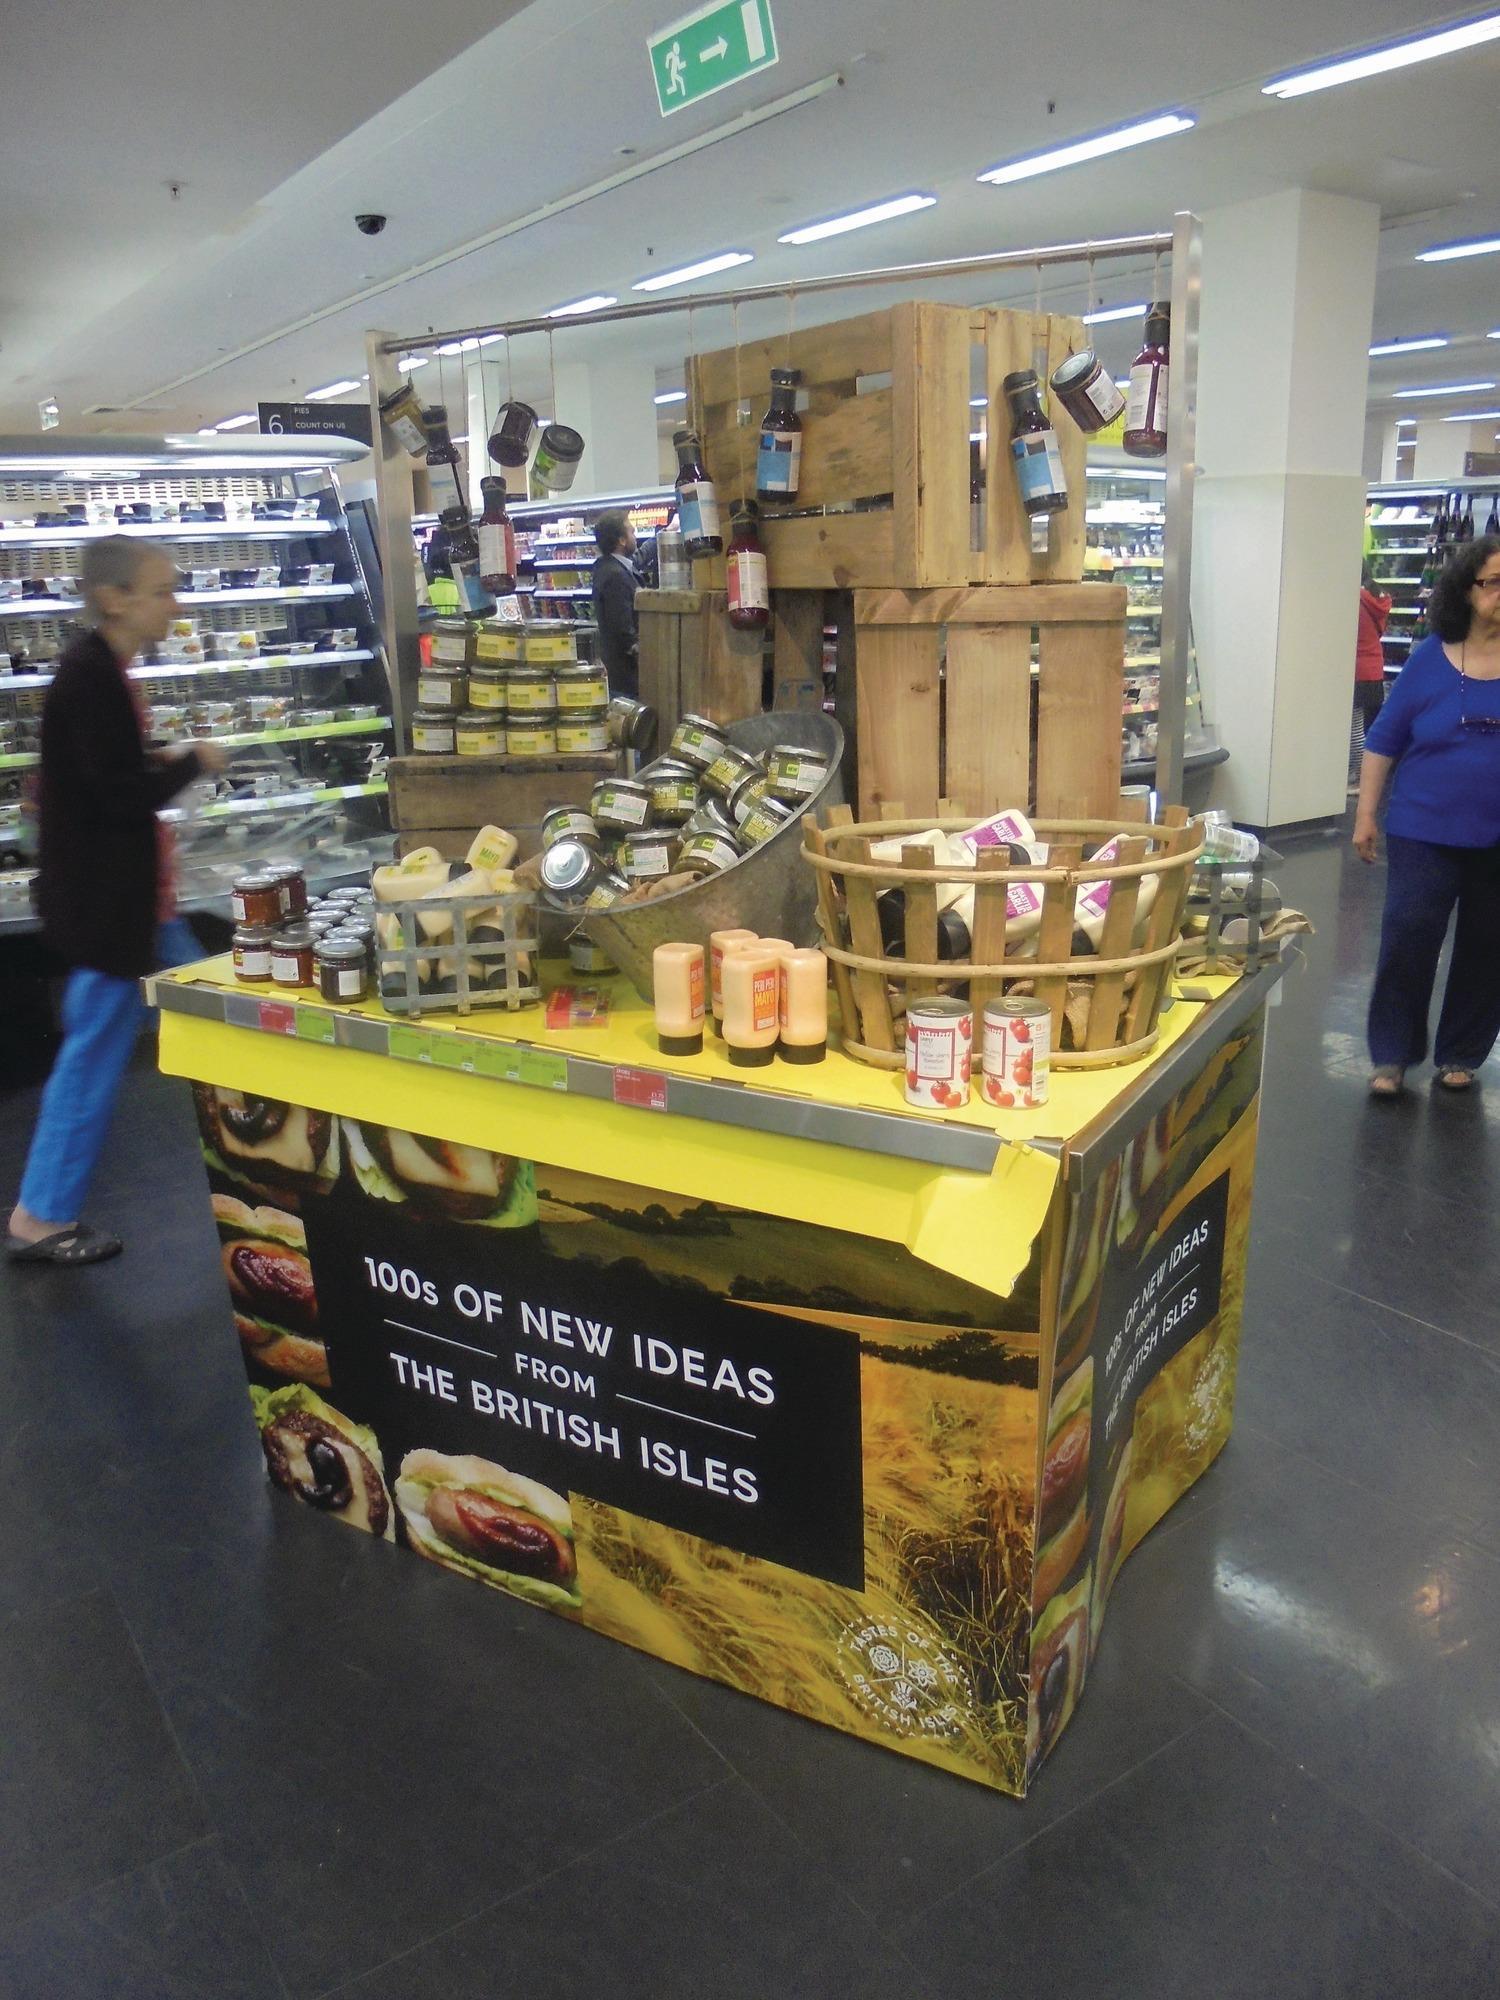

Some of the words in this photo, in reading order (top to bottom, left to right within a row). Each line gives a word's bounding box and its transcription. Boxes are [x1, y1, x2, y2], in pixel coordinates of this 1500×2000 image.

[268, 414, 284, 435] 6
[1007, 890, 1028, 914] GARLIC
[1017, 887, 1033, 912] ROASTED
[1124, 1295, 1140, 1334] OF
[1140, 1259, 1168, 1310] NEW
[1168, 1219, 1209, 1273] IDEAS
[364, 1256, 439, 1306] 100s
[453, 1283, 503, 1323] OF
[520, 1301, 613, 1358] NEW
[633, 1333, 775, 1405] IDEAS
[1134, 1303, 1157, 1344] FROM
[1120, 1325, 1159, 1402] BRITISH
[1161, 1287, 1198, 1337] ISLES
[514, 1352, 596, 1398] FROM
[389, 1352, 458, 1403] THE
[470, 1379, 621, 1460] BRITISH
[640, 1436, 759, 1503] ISLES
[850, 1625, 898, 1653] TASTES
[906, 1631, 930, 1650] OF
[934, 1651, 960, 1686] THE
[853, 1674, 911, 1726] BRITISH
[919, 1704, 958, 1729] ISLES
